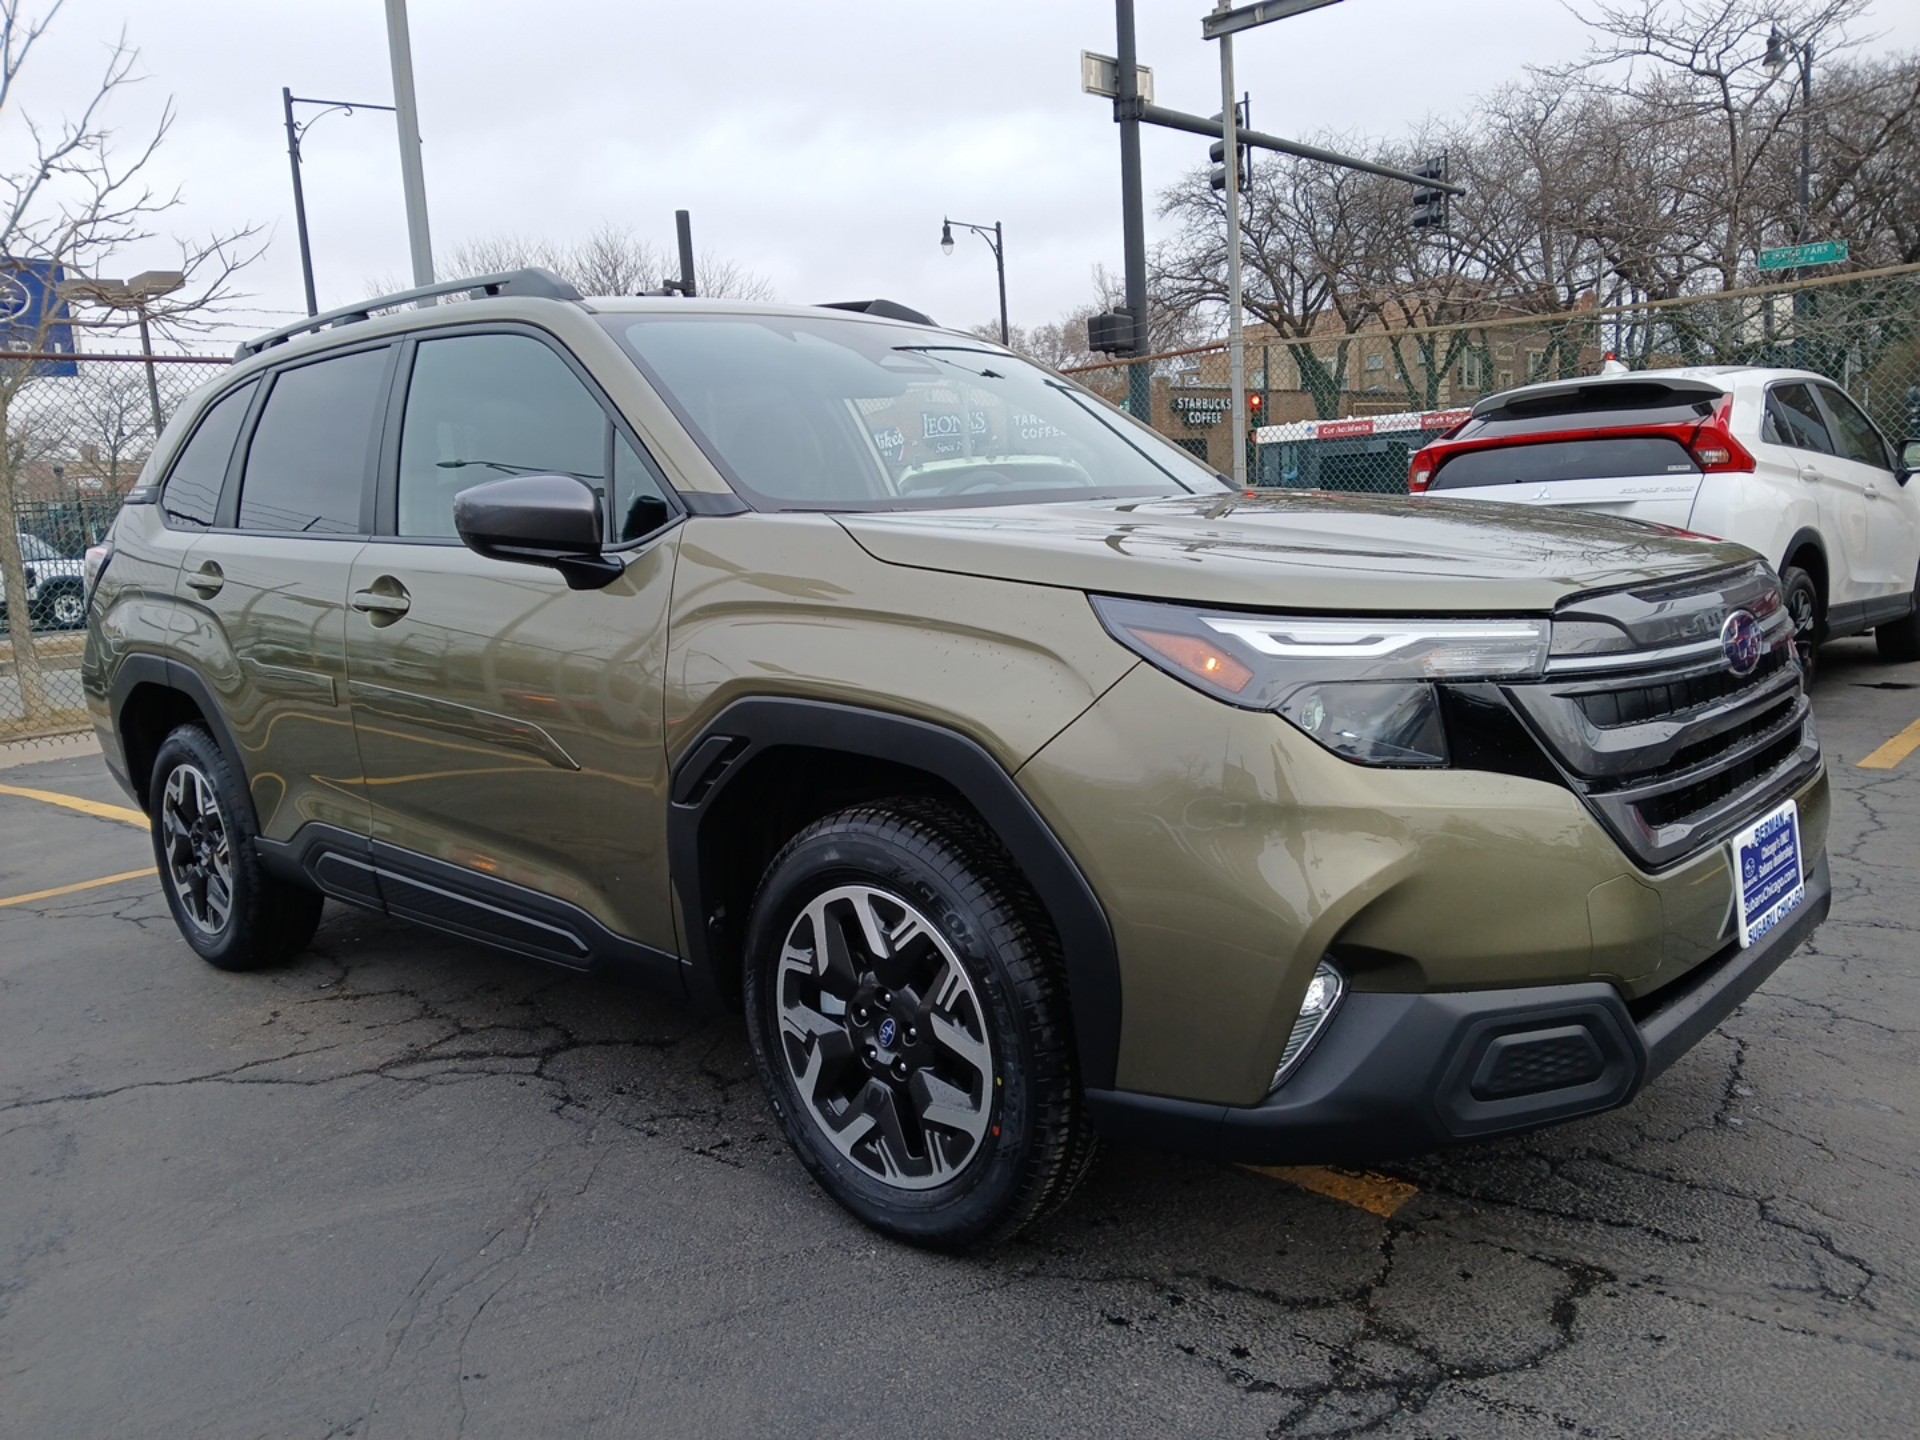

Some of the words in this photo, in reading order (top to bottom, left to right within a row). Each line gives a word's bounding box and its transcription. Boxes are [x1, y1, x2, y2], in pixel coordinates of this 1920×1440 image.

[1177, 396, 1232, 410] STARBUCKS
[1188, 411, 1222, 424] COFFEE
[1754, 810, 1785, 845] BERMAN
[1744, 867, 1797, 917] SubaruChicago.com
[1748, 909, 1777, 946] SUBARU
[1777, 885, 1805, 922] CHICAGO
